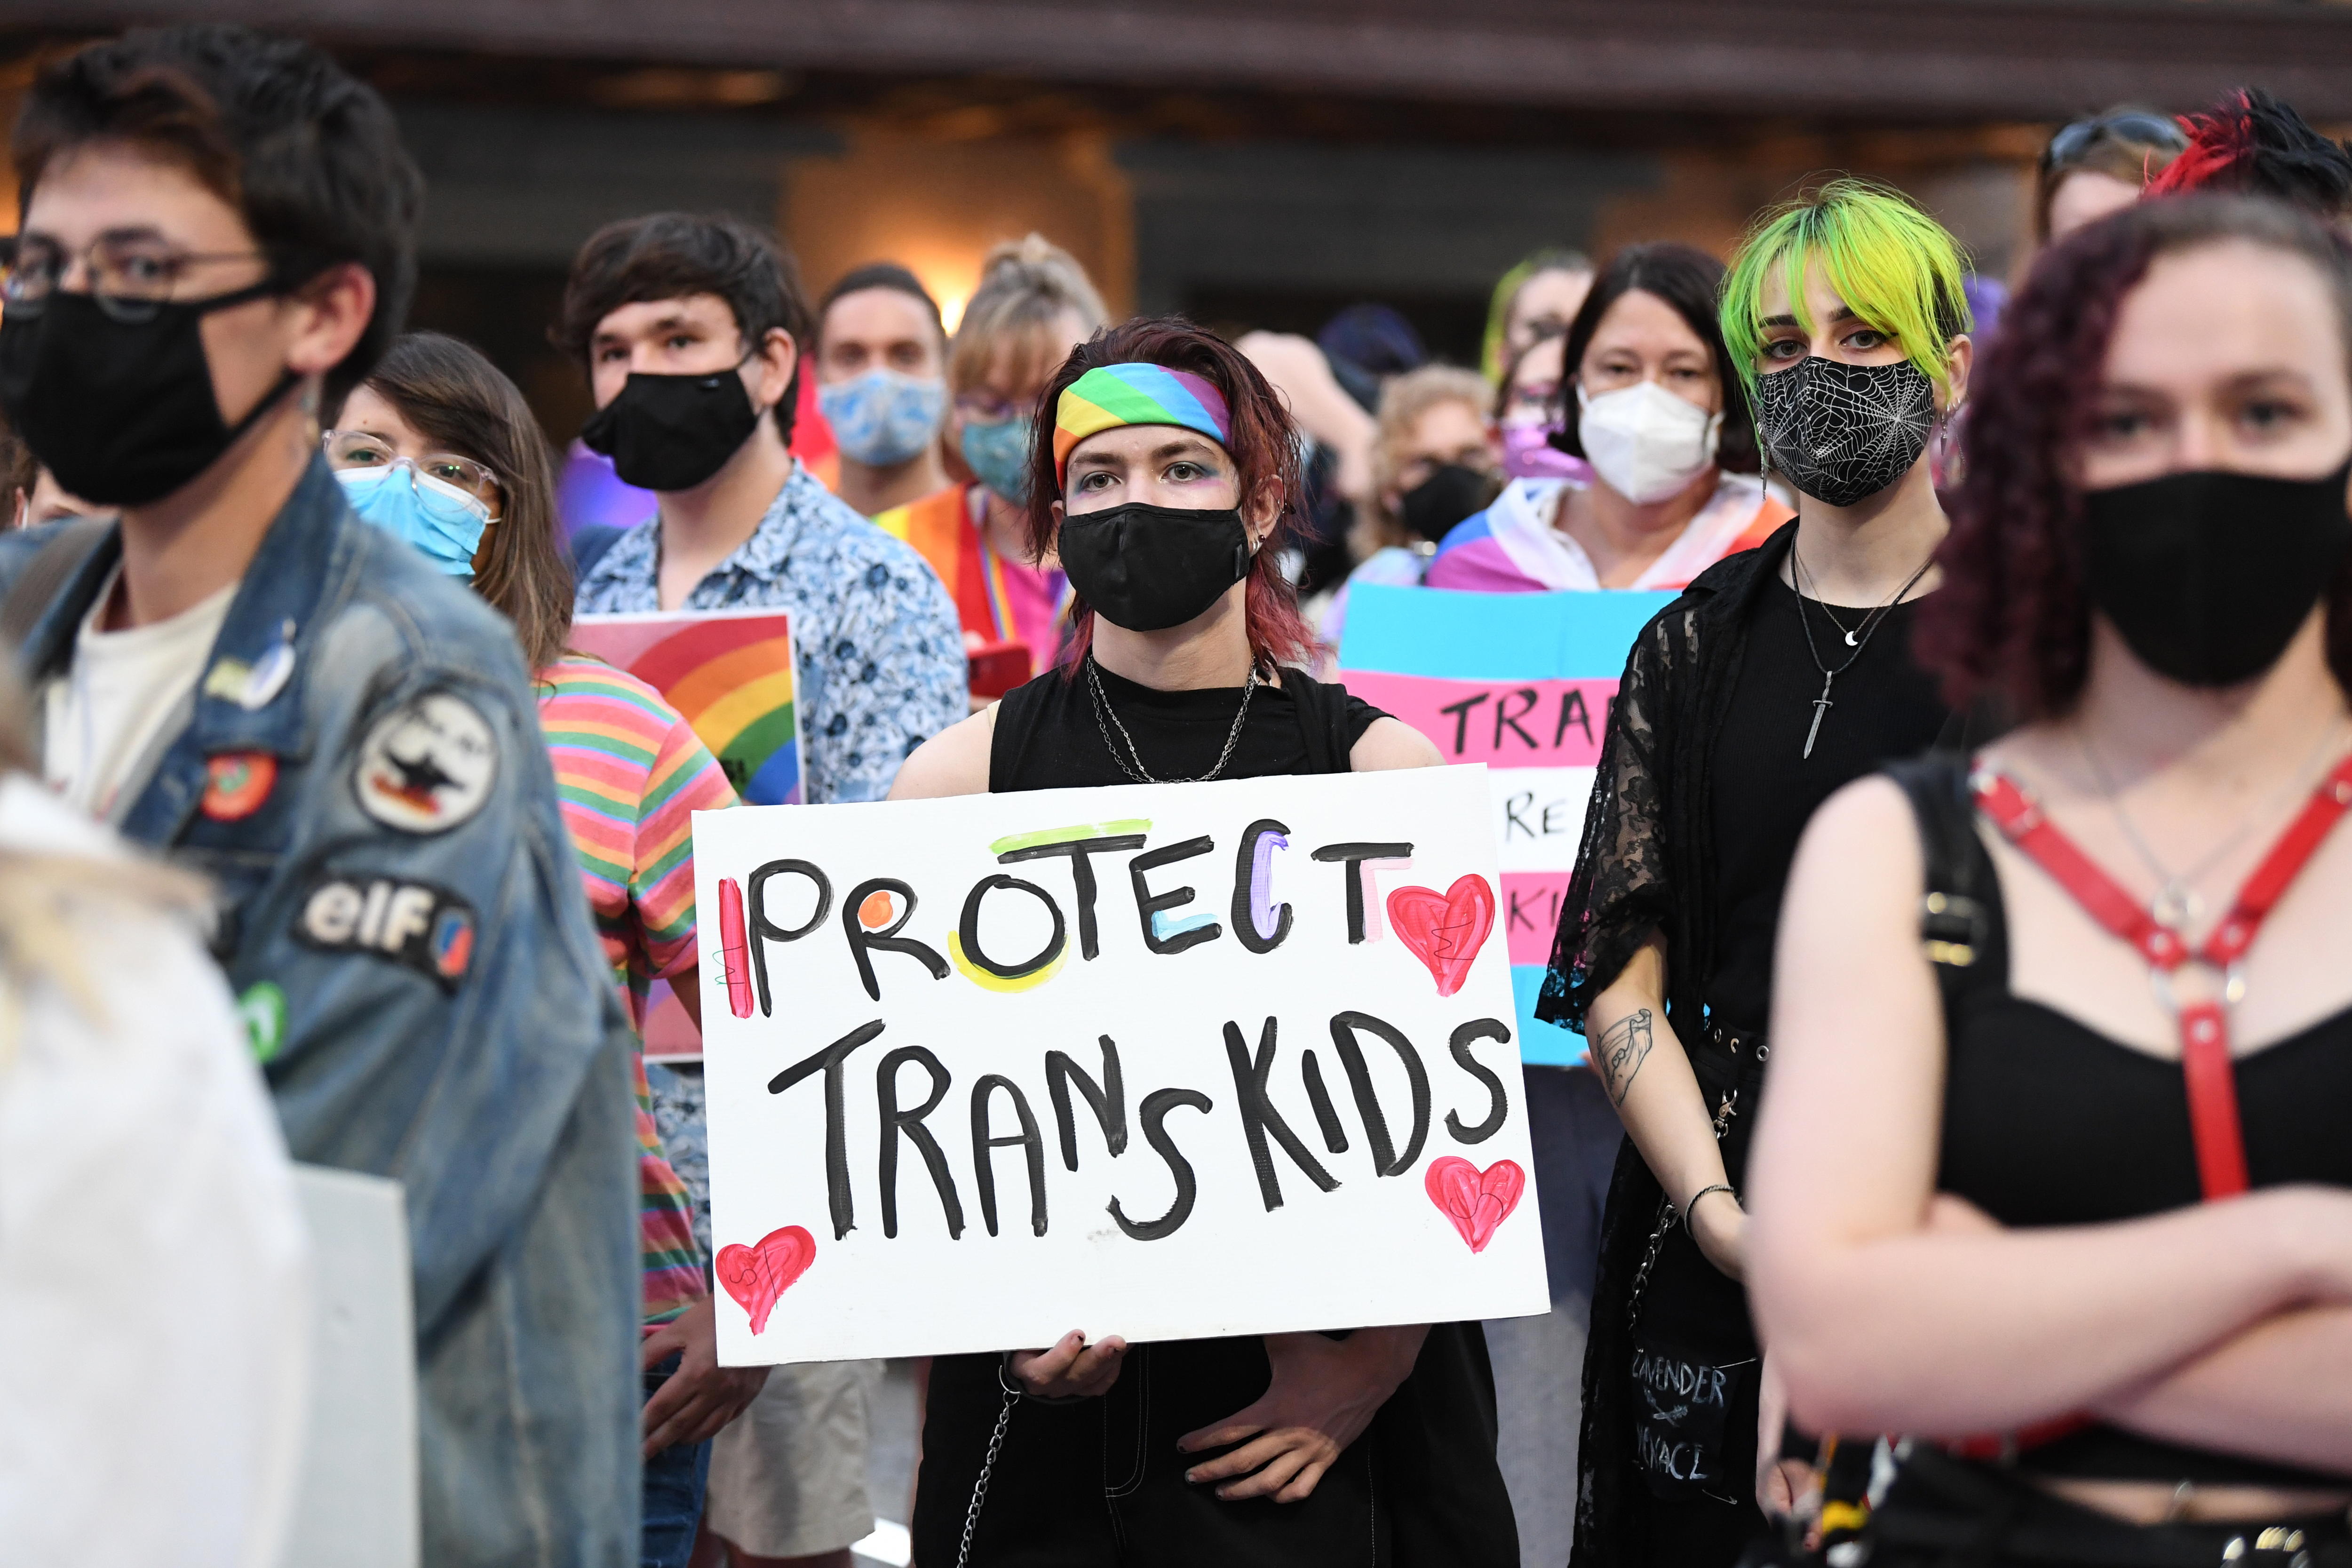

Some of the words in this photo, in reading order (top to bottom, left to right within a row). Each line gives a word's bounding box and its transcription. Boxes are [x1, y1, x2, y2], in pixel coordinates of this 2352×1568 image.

[747, 819, 1414, 1018] PROTECT
[767, 1019, 1214, 1241] TRANS
[1223, 1011, 1511, 1213] KIDS
[1632, 1353, 1726, 1408] LAVENDER
